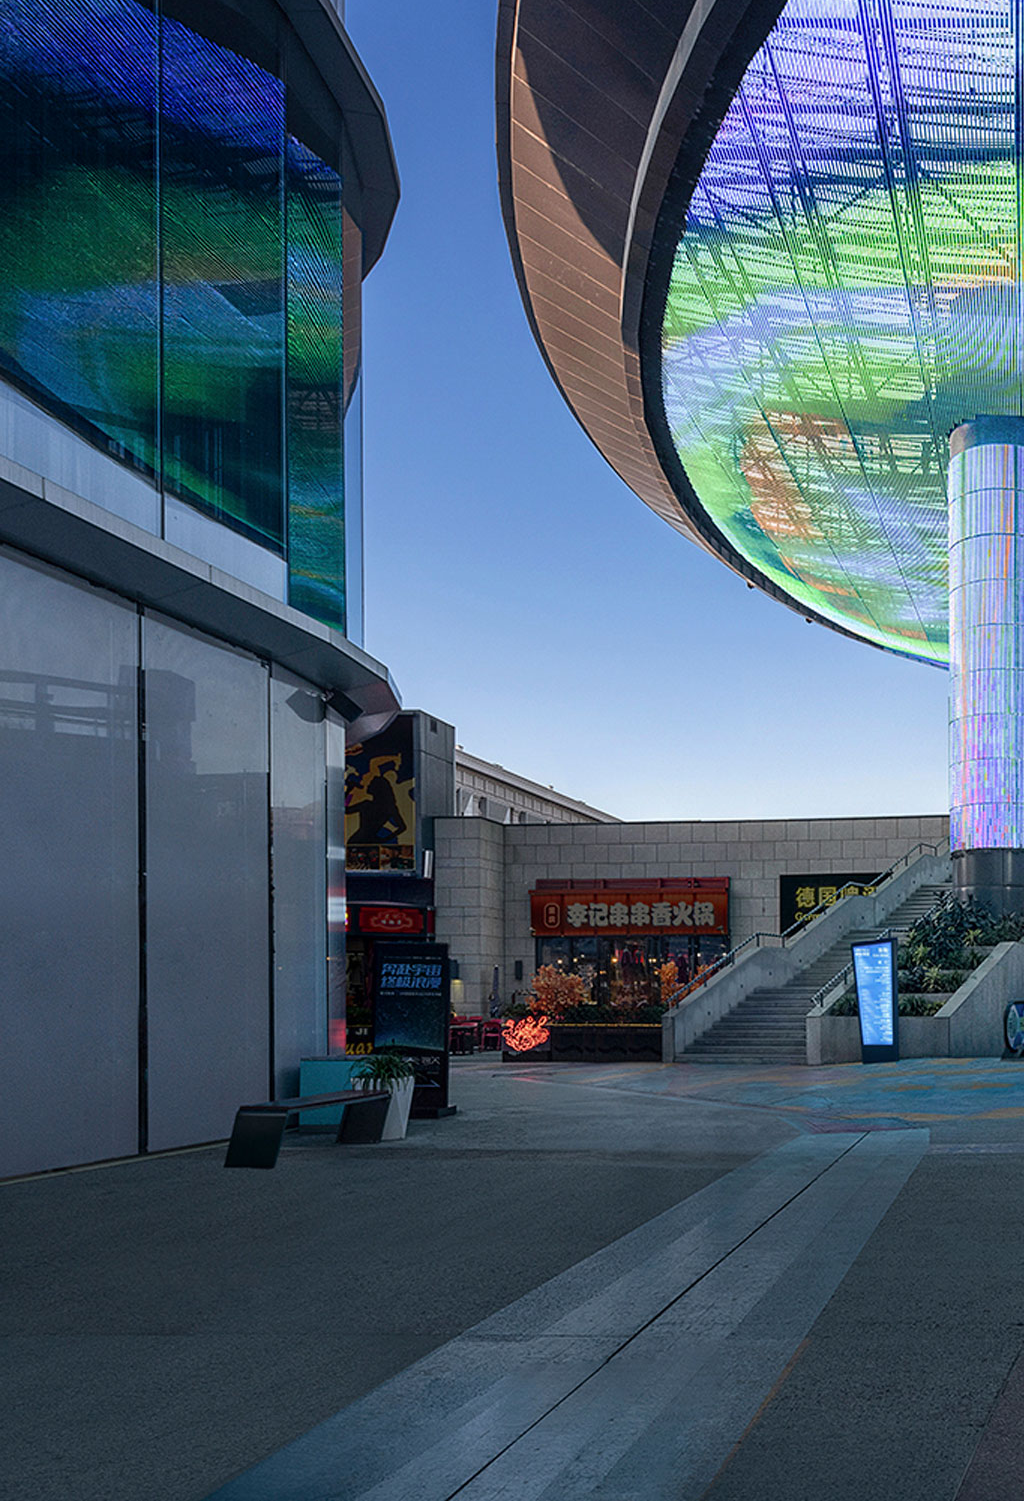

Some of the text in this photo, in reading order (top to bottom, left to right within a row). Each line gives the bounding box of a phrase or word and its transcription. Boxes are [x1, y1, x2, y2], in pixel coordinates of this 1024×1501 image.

[567, 901, 715, 928] 李记串串香火锅
